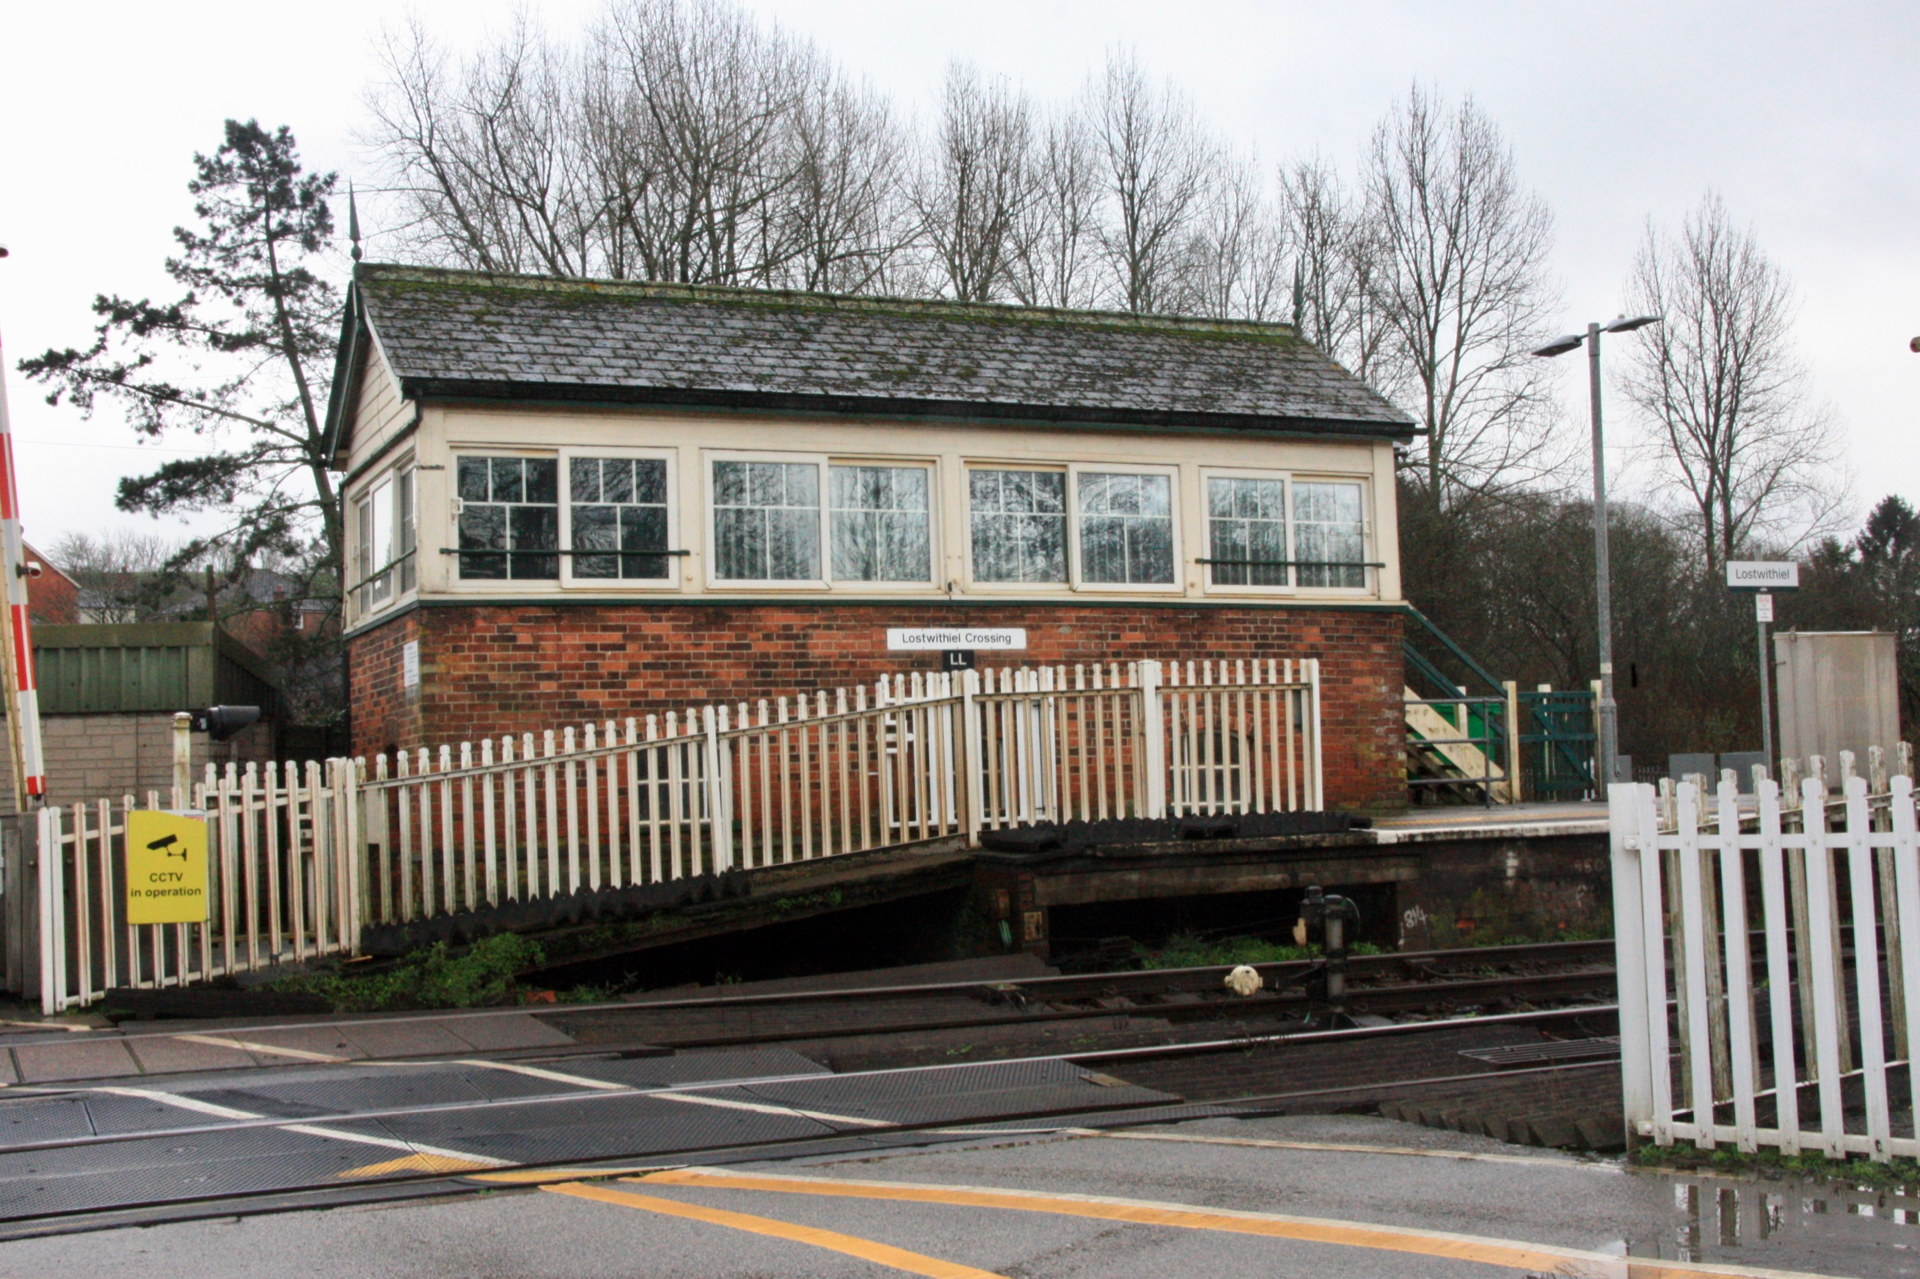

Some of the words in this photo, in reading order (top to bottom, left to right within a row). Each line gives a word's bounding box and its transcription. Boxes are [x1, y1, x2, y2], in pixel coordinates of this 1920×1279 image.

[1735, 568, 1790, 580] Lostwithiel
[902, 633, 961, 643] Lostwithiel
[965, 633, 1012, 645] Crossing
[950, 653, 967, 666] LL
[149, 872, 183, 882] CCTV
[130, 888, 141, 897] in
[145, 887, 201, 898] operation
